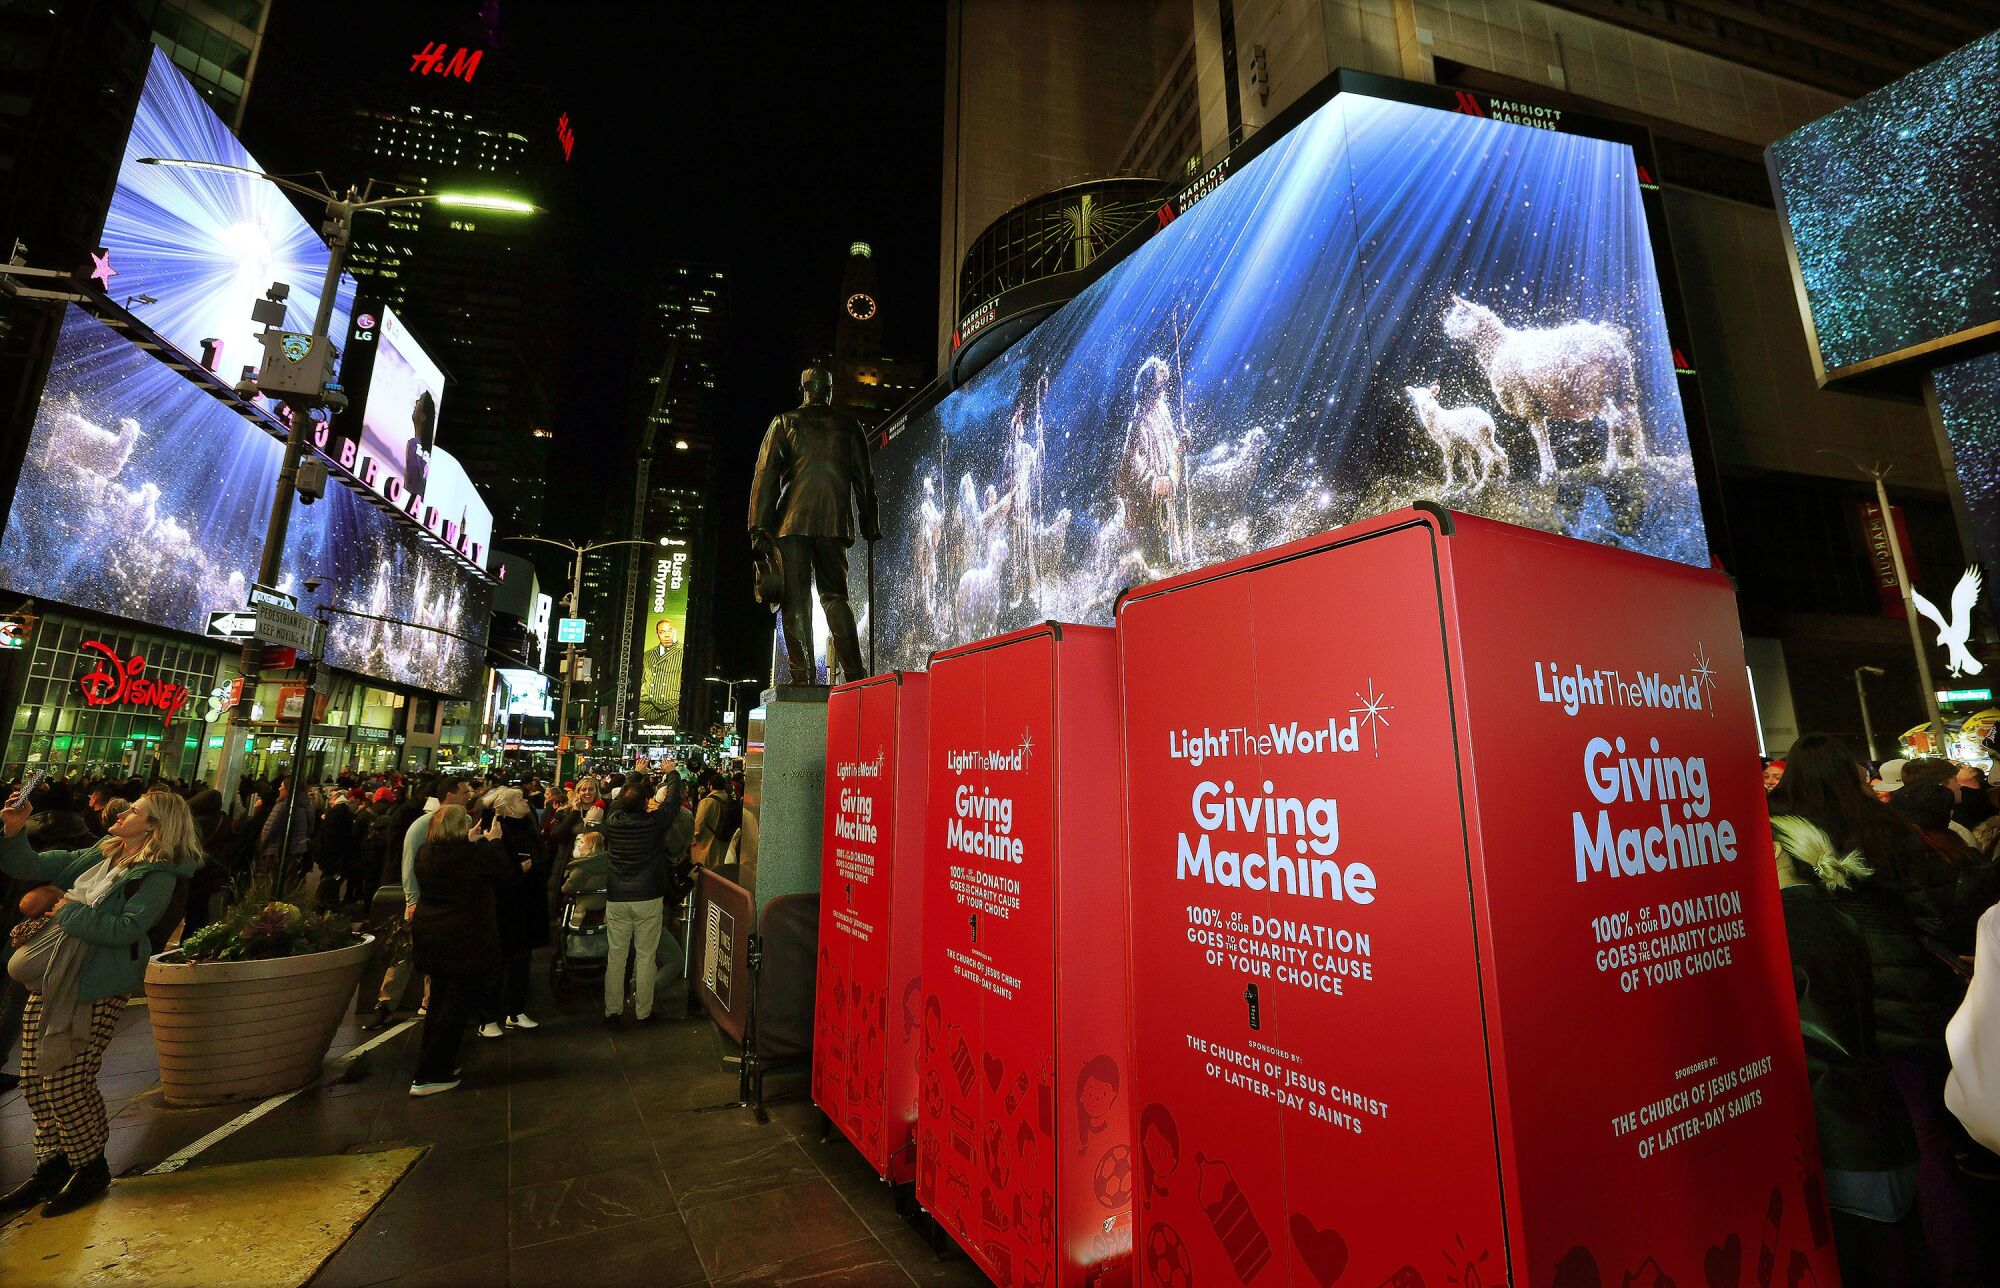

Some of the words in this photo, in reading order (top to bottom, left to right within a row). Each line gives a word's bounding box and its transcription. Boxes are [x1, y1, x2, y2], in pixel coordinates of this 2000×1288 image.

[410, 41, 484, 84] H&M
[1490, 98, 1562, 121] MARRIOTT
[1492, 111, 1556, 131] MARQUIS
[556, 112, 574, 162] H&M
[1179, 156, 1231, 203] MARRIOTT
[1179, 174, 1226, 213] MARQUIS
[962, 298, 1000, 330] MARRIOTT
[962, 310, 995, 340] MARQUIS
[355, 330, 372, 340] LG
[338, 438, 484, 564] BROADWAY
[654, 560, 672, 613] Rhymes
[671, 553, 686, 590] Busta
[260, 607, 298, 628] PEDESTRIAN
[277, 600, 290, 608] WAY
[222, 619, 245, 628] ONE
[259, 623, 273, 638] KEEP
[276, 629, 299, 644] MOVING
[1534, 661, 1702, 716] LightTheWorld
[1169, 716, 1359, 767] LightTheWorld
[948, 748, 1022, 775] LightTheWorld
[1584, 736, 1710, 818] Giving
[840, 788, 872, 823] Giving
[955, 784, 1012, 834] Giving
[1192, 780, 1339, 855] Giving
[835, 813, 877, 844] Machine
[946, 818, 1024, 864] Machine
[1572, 804, 1738, 883] Machine
[850, 851, 874, 866] DONATION
[1176, 832, 1377, 904] Machine
[950, 865, 965, 880] 100%
[976, 872, 1020, 895] DONATION
[950, 880, 965, 892] GOES
[970, 886, 998, 904] CHARITY
[998, 892, 1020, 909] CAUSE
[957, 894, 965, 904] OF
[966, 896, 983, 910] YOUR
[984, 901, 1009, 919] CHOICE
[1186, 905, 1222, 929] 100%
[1230, 911, 1242, 922] OF
[1639, 907, 1650, 920] OF
[1658, 890, 1742, 930] DONATION
[1187, 927, 1224, 949] GOES
[1225, 920, 1249, 934] YOUR
[1226, 934, 1235, 943] TO
[1252, 915, 1371, 957] DONATION
[1592, 910, 1633, 943] 100%
[1635, 920, 1658, 935] YOUR
[1708, 920, 1746, 944] CAUSE
[1226, 942, 1238, 952] THE
[1238, 938, 1307, 966] CHARITY
[1596, 943, 1638, 972] GOES
[1638, 941, 1648, 952] TO
[1638, 951, 1650, 962] THE
[1651, 929, 1706, 959] CHARITY
[946, 948, 955, 960] THE
[956, 952, 976, 970] CHURCH
[978, 960, 984, 972] OF
[985, 964, 1000, 982] JESUS
[1002, 971, 1022, 990] CHRIST
[1206, 950, 1224, 966] OF
[1228, 954, 1271, 978] YOUR
[1276, 965, 1343, 996] CHOICE
[1312, 953, 1372, 980] CAUSE
[1620, 970, 1640, 993] OF
[1643, 959, 1682, 987] YOUR
[1685, 946, 1732, 976] CHOICE
[954, 965, 961, 976] OF
[962, 968, 992, 992] LATTER-DAY
[993, 981, 1012, 1000] SAINTS
[1248, 1040, 1290, 1059] SPONSORED
[1291, 1054, 1302, 1064] BY:
[1186, 1034, 1207, 1053] THE
[1210, 1044, 1260, 1072] CHURCH
[1264, 1062, 1281, 1079] OF
[1285, 1070, 1327, 1096] JESUS
[1331, 1086, 1388, 1118] CHRIST
[1675, 1061, 1708, 1080] SPONSORED
[1709, 1057, 1718, 1068] BY:
[1206, 1063, 1221, 1079] OF
[1224, 1069, 1304, 1111] LATTER-DAY
[1308, 1102, 1362, 1134] SAINTS
[1612, 1111, 1637, 1136] THE
[1640, 1090, 1689, 1126] CHURCH
[1691, 1083, 1706, 1104] OF
[1707, 1070, 1738, 1102] JESUS
[1739, 1056, 1772, 1084] CHRIST
[1638, 1136, 1655, 1159] OF
[1658, 1106, 1727, 1150] LATTER-DAY
[1728, 1090, 1762, 1120] SAINTS
